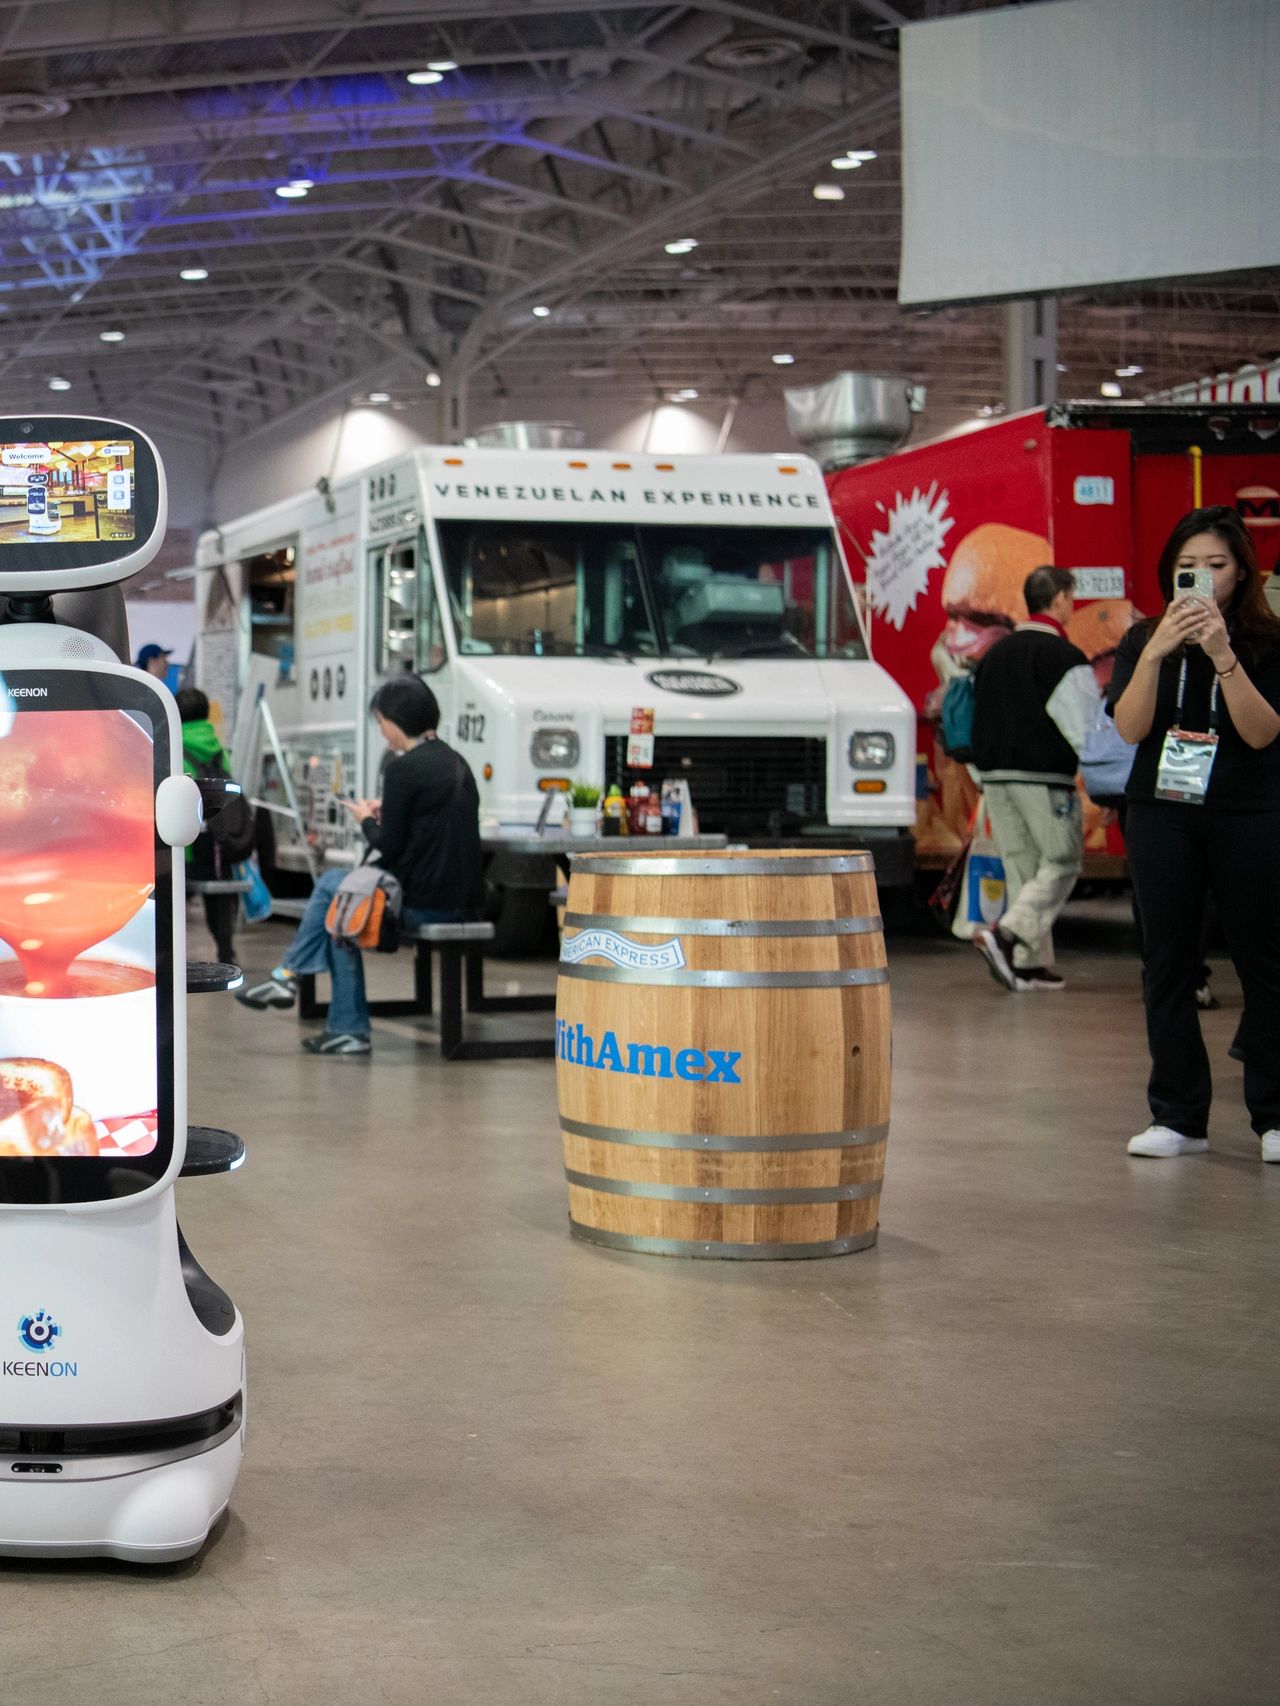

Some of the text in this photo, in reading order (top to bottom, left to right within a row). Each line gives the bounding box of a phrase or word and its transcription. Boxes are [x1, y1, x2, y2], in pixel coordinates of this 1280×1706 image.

[435, 484, 820, 509] VENEZUELAN EXPERIENCE
[8, 687, 48, 697] KEENON
[561, 936, 670, 966] MERICAN EXPRESS
[3, 1361, 77, 1377] KEENON
